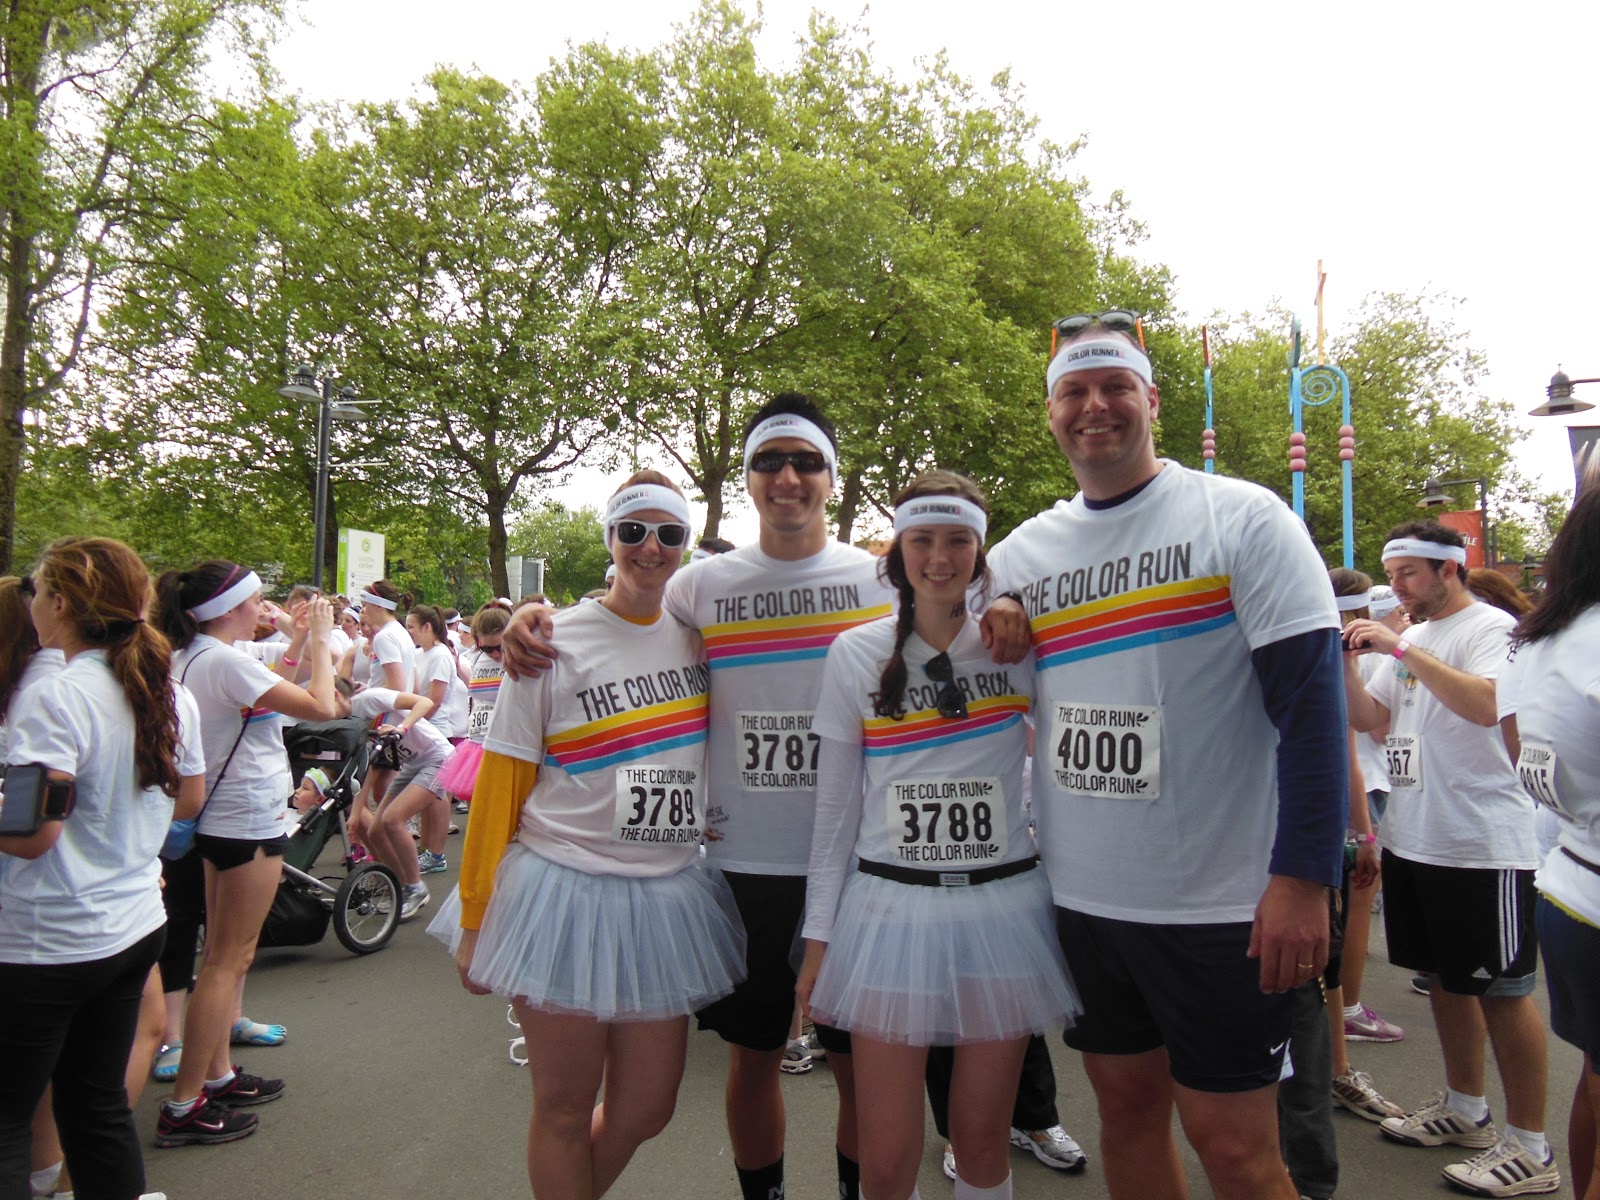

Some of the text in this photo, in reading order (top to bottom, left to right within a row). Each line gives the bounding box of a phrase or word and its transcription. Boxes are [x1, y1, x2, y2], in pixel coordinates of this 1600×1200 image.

[1068, 348, 1120, 362] COLOR RUNNER
[910, 504, 956, 516] COLOR RUNNER
[1022, 542, 1192, 619] THE COLOR RUN
[714, 584, 861, 623] THE COLOR RUN
[477, 668, 500, 679] COLOR
[576, 682, 625, 722] THE
[623, 669, 686, 708] COLOR
[908, 676, 975, 711] COR
[741, 715, 814, 730] THE COLOR RU
[1059, 706, 1136, 728] THE COLOR RUN
[744, 732, 821, 771] 3787
[1057, 727, 1142, 775] 4000
[625, 769, 693, 785] THE COLOR RUN
[742, 772, 760, 787] THE
[761, 773, 798, 787] COLOR
[1055, 769, 1134, 794] THE COLOR RUN
[895, 781, 983, 800] THE COLOR RUN
[627, 785, 696, 826] 3789
[899, 801, 992, 843] 3788
[620, 827, 695, 843] THE COLOR RUN
[898, 843, 988, 861] THE COLOR RUN
